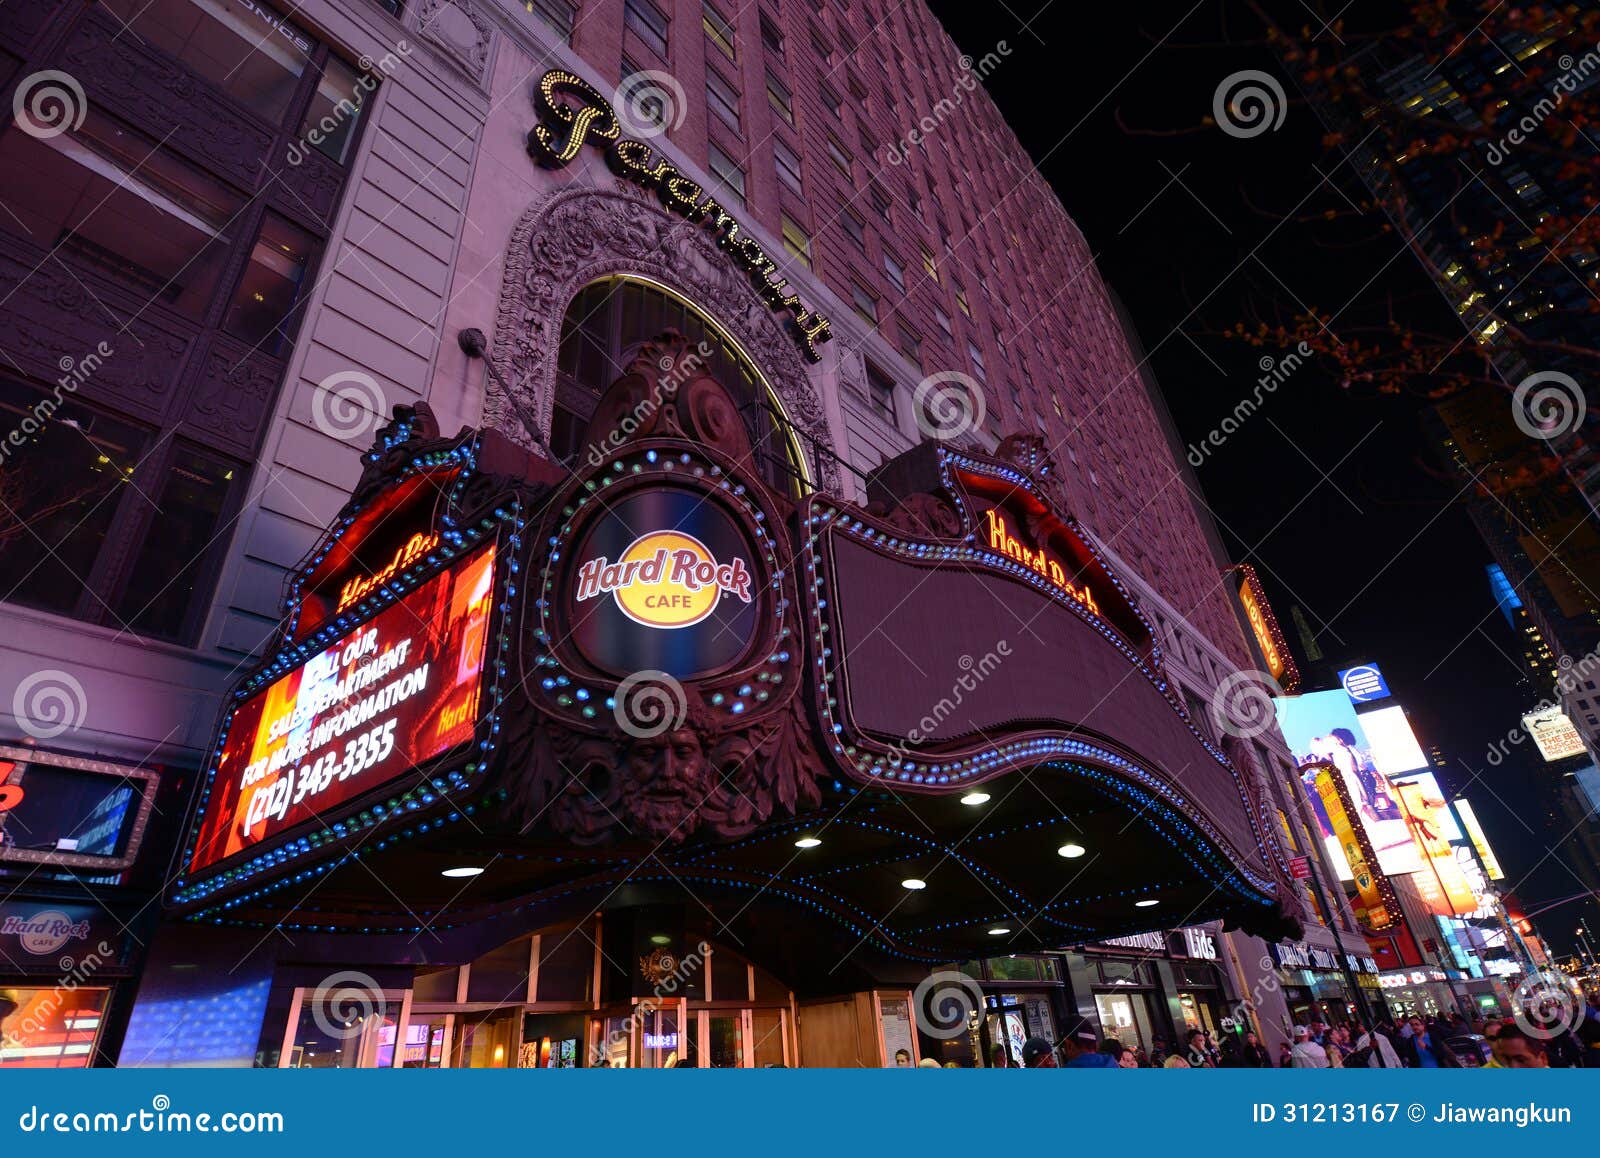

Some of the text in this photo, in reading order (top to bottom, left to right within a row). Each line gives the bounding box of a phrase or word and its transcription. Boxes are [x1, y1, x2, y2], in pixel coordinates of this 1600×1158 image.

[528, 69, 833, 364] Paramount
[986, 510, 1047, 577] Hard
[577, 549, 752, 603] Hard Rock
[645, 594, 692, 608] CAFE
[342, 628, 378, 667] OUR
[240, 756, 269, 790] FOR
[269, 731, 312, 778] MORE
[311, 663, 429, 751] INFORMATION
[244, 718, 397, 837] (212) 343-3355
[0, 915, 91, 940] Hard Rock
[1187, 928, 1216, 960] Lids
